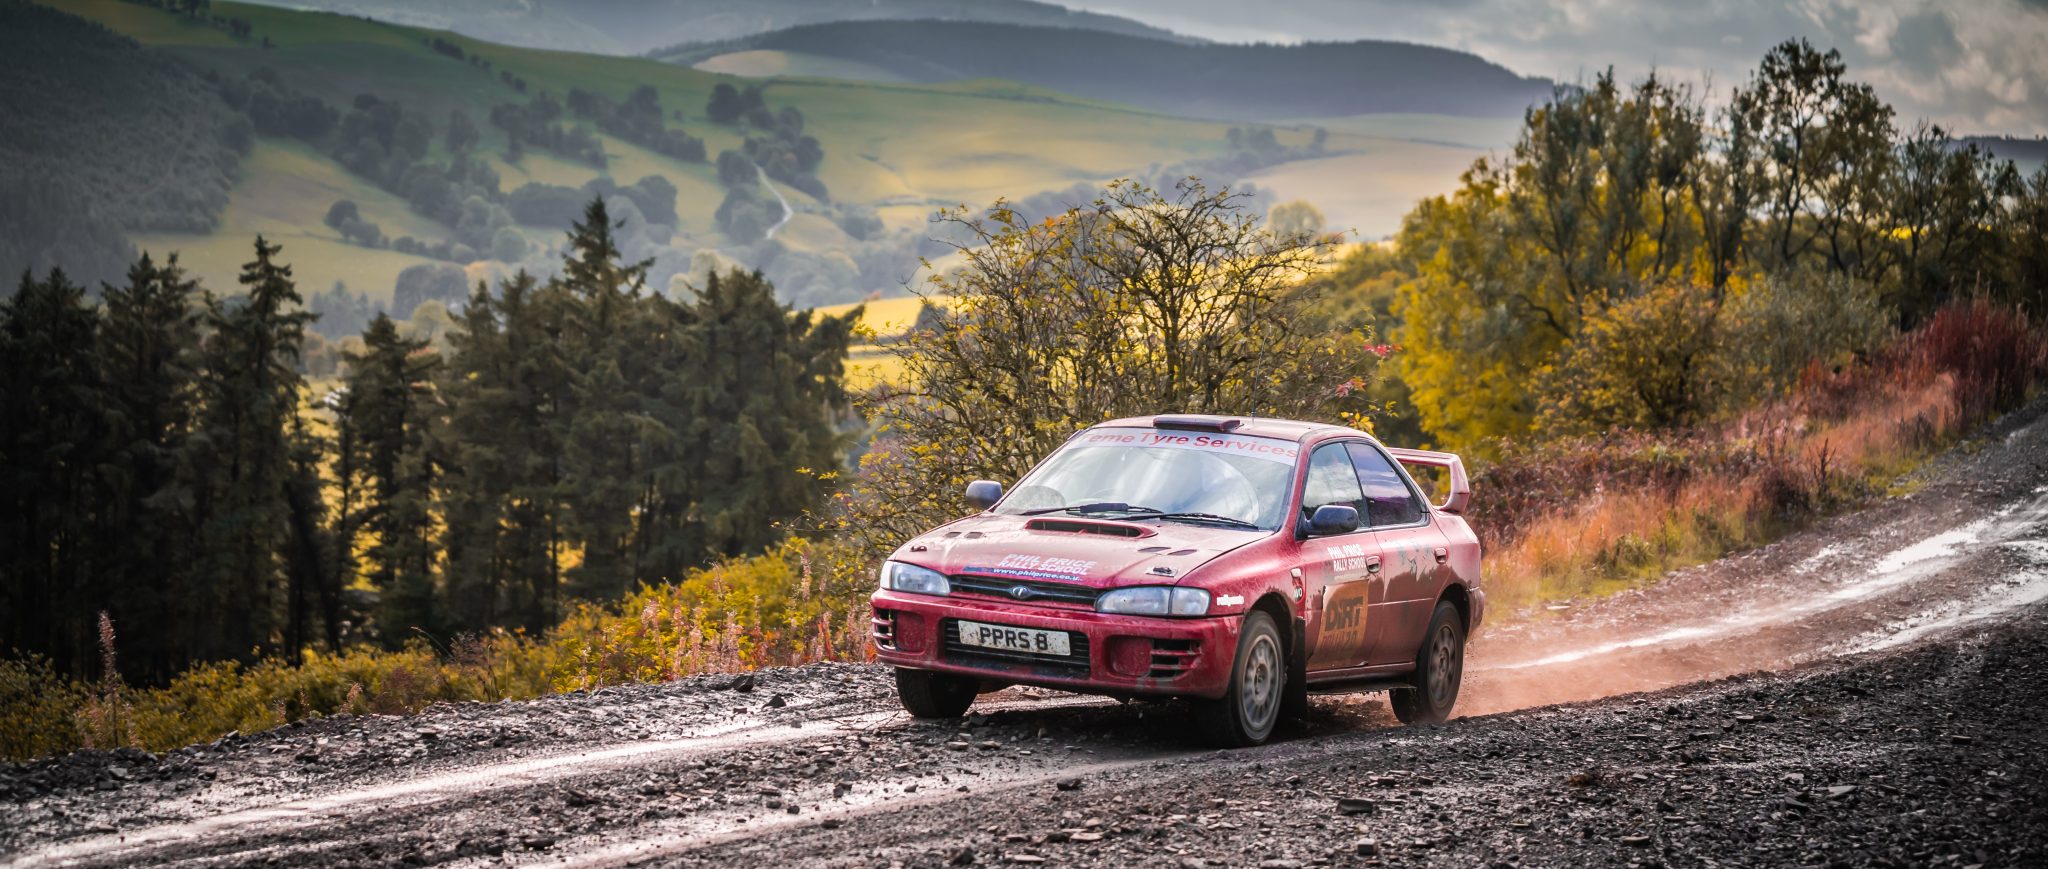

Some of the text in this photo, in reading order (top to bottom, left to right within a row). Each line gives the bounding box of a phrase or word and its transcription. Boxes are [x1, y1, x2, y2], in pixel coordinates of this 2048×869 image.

[1140, 432, 1189, 446] Tyre
[1195, 436, 1297, 458] Services
[999, 561, 1088, 575] RALLY SCHOOL
[1004, 554, 1096, 568] PHIL PRICE
[1334, 559, 1348, 571] RALLY
[993, 568, 1083, 581] www.philprice.co.u
[979, 626, 1049, 651] PPRS 8
